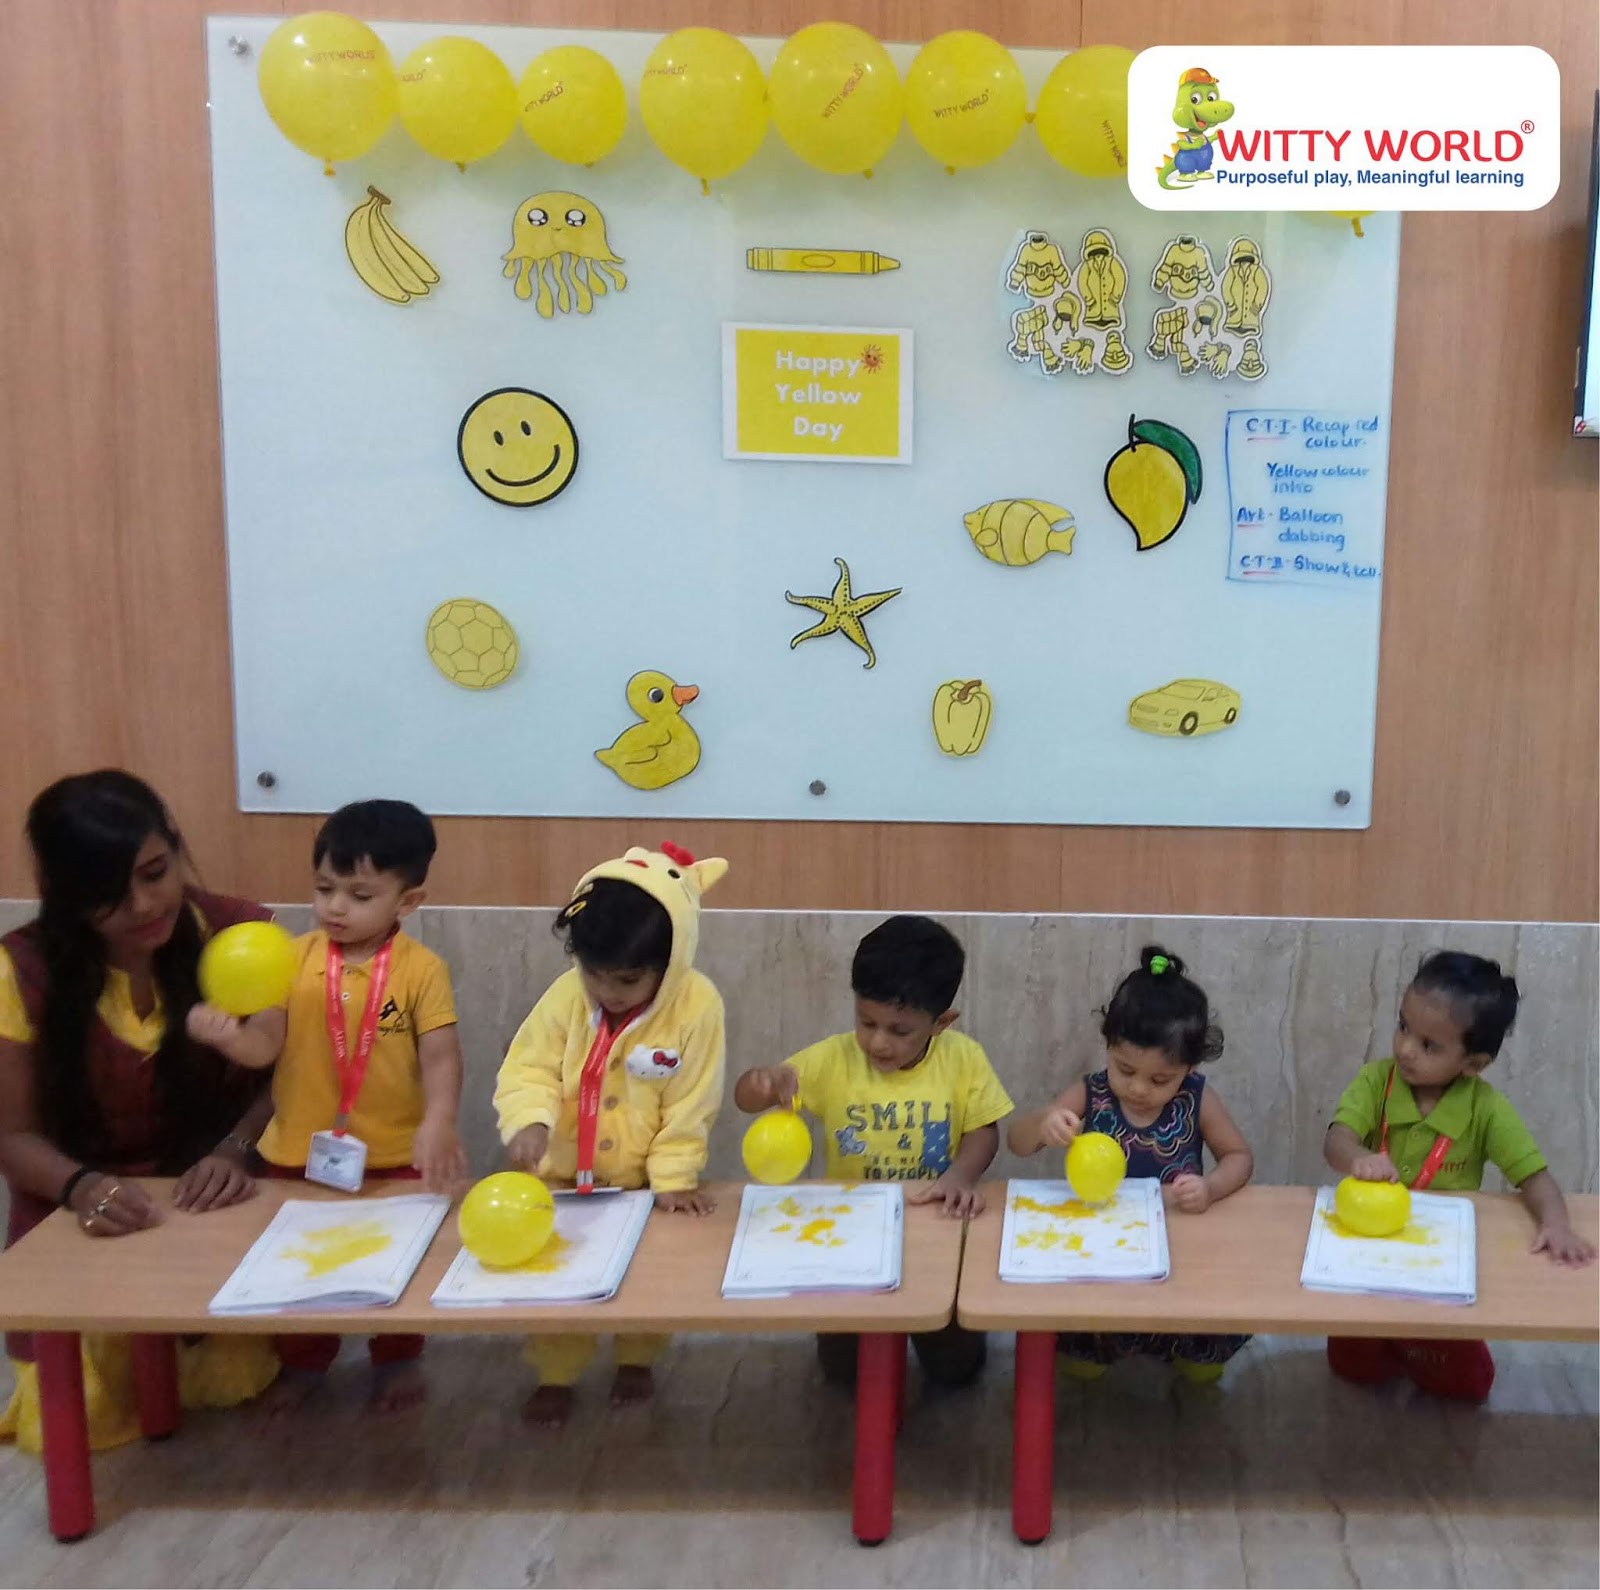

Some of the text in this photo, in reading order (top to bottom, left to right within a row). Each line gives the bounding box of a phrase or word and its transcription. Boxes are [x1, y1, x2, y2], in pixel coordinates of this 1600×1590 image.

[932, 93, 989, 119] WITTY WORLD
[775, 349, 861, 379] Happy
[775, 382, 862, 404] Yellow
[793, 416, 843, 442] Day
[1303, 415, 1349, 437] Recap
[1356, 416, 1378, 431] red
[1267, 462, 1318, 478] Yellow
[1279, 506, 1344, 525] Balloon
[1278, 528, 1346, 551] dabbing
[1294, 554, 1340, 574] Show
[897, 1133, 912, 1150] &
